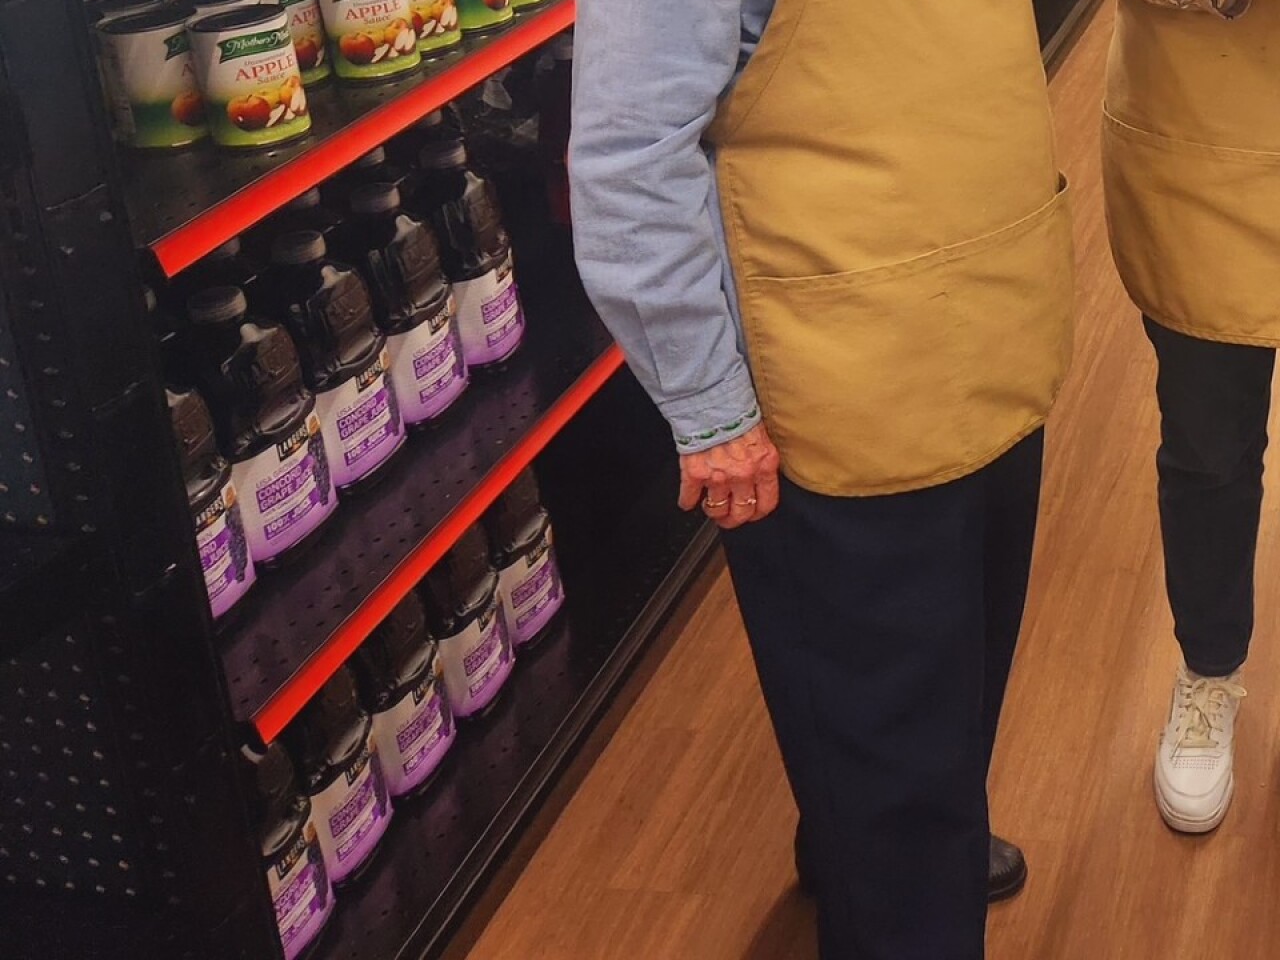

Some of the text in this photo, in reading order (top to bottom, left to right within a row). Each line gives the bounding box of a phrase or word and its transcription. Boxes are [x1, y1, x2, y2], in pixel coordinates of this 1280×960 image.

[291, 4, 320, 26] APP
[364, 14, 391, 25] Sauce
[235, 54, 294, 82] APPLE
[257, 73, 285, 85] Sauce
[339, 397, 378, 429] CONCORD
[340, 415, 369, 439] GRAPE
[255, 474, 273, 488] USA
[258, 465, 302, 500] CONCORD
[260, 486, 292, 513] GRAPE
[265, 513, 290, 533] 100%
